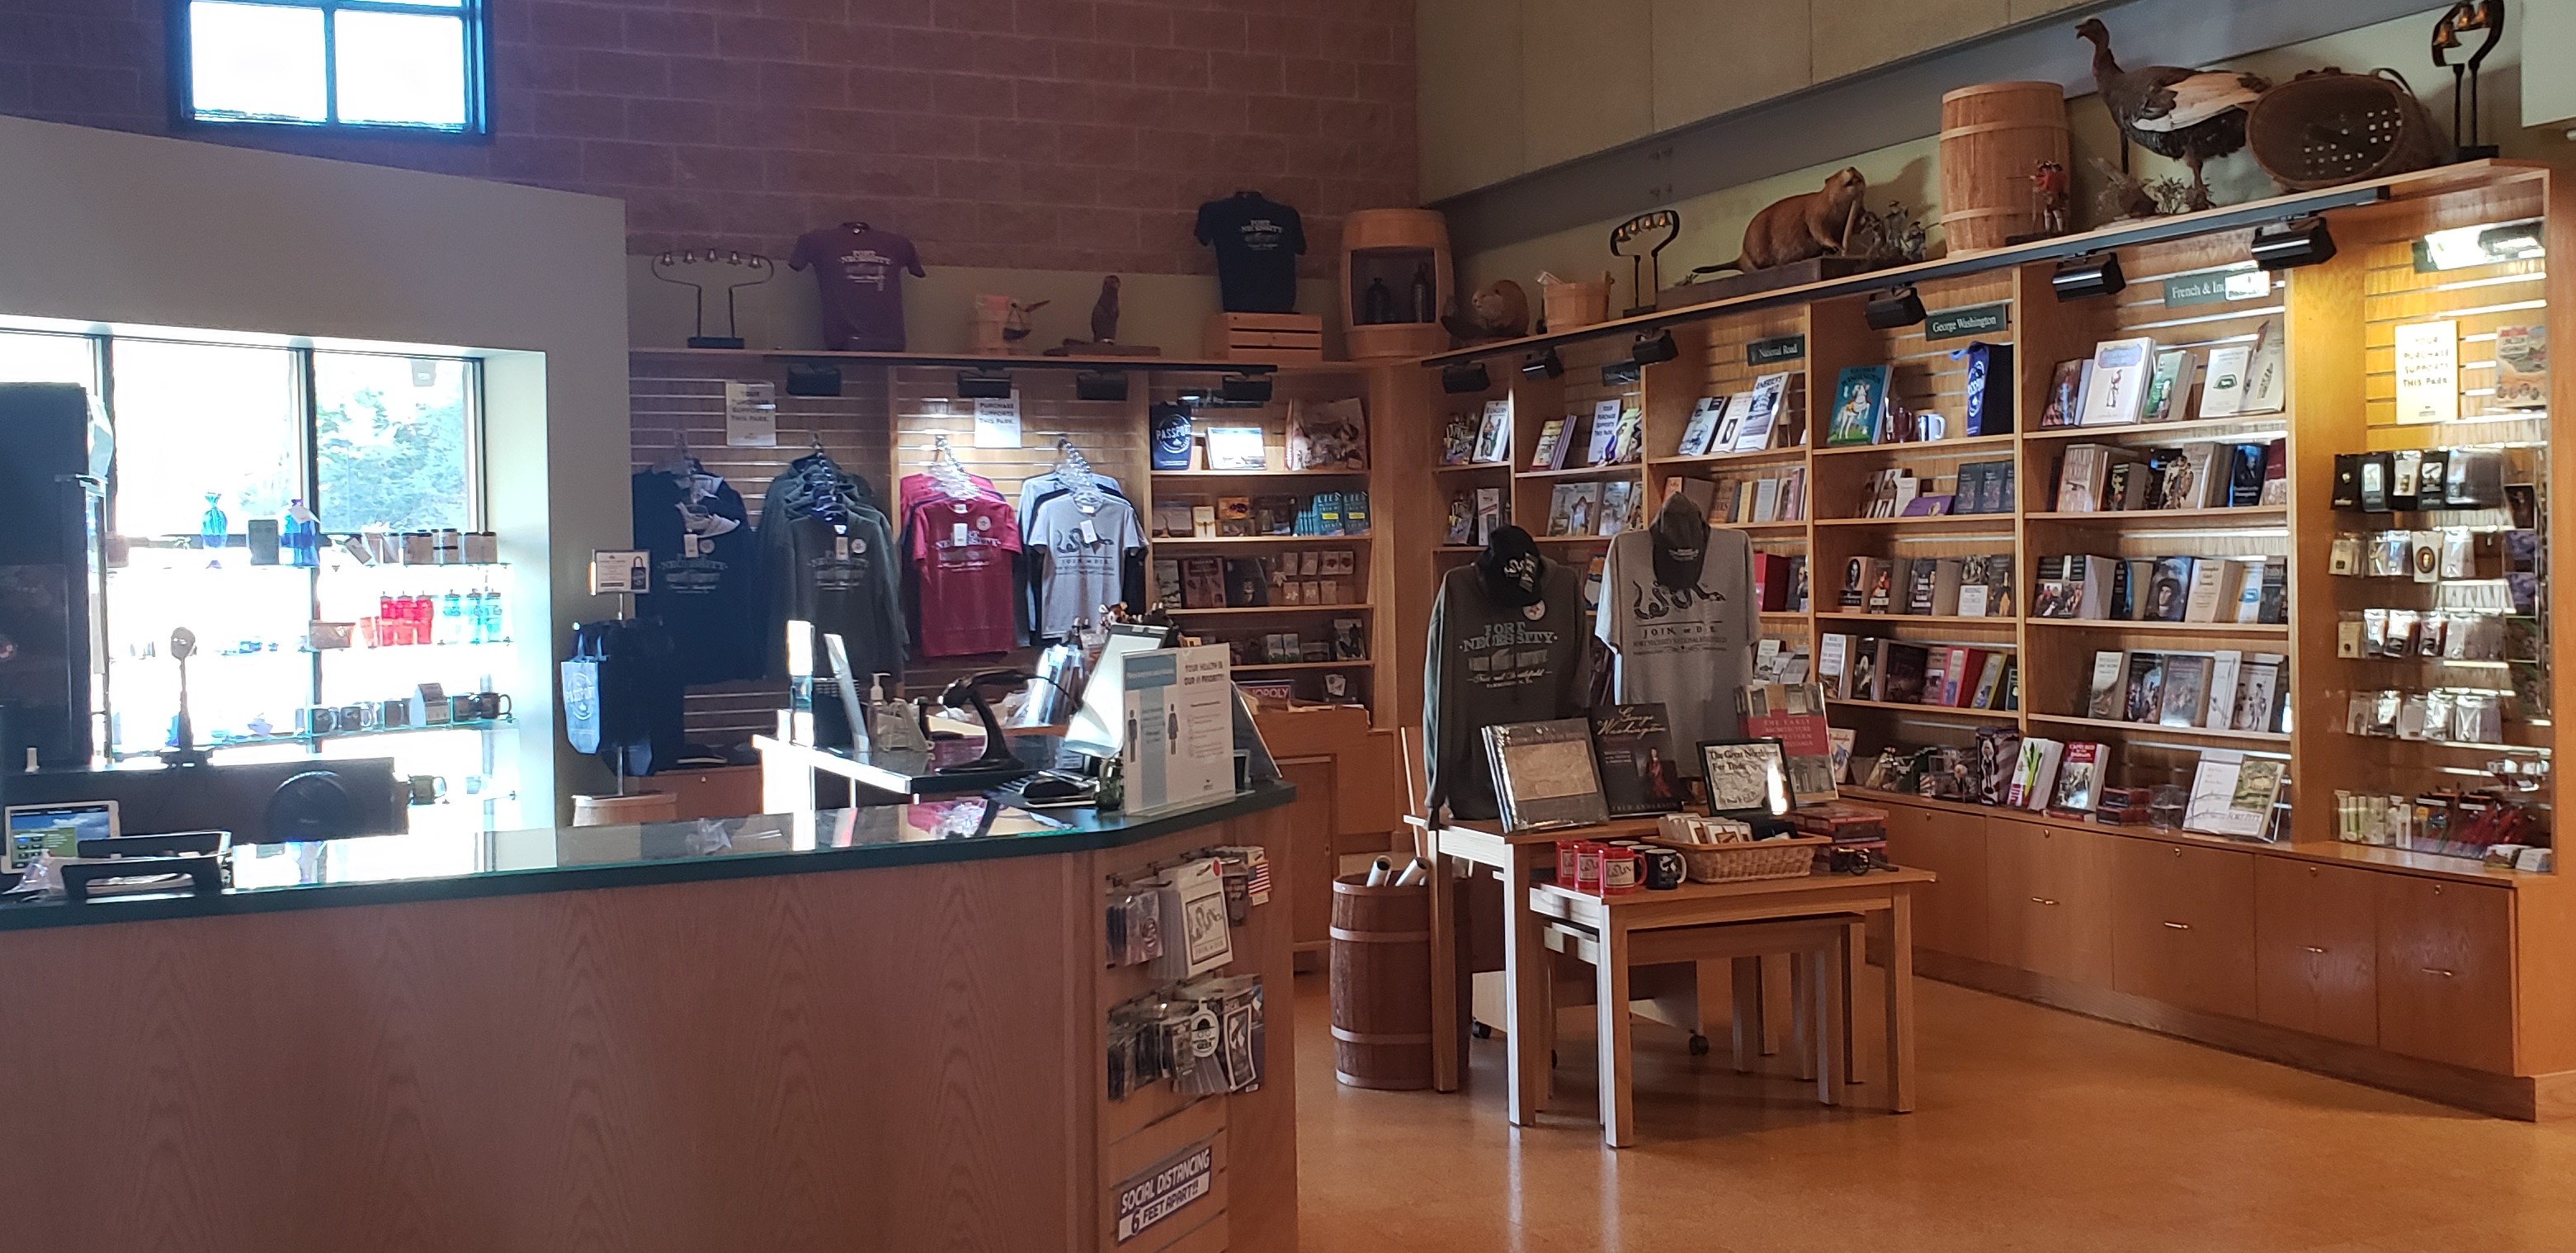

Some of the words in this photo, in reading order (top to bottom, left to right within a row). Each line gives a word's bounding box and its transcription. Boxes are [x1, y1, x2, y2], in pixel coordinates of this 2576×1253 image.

[2172, 285, 2201, 299] French
[2202, 281, 2210, 295] &
[1932, 322, 1956, 333] George
[1956, 316, 1997, 328] Washington
[1758, 346, 1782, 357] National
[1782, 343, 1798, 355] Road
[2403, 379, 2422, 387] THIS
[1317, 494, 1340, 503] LIES
[1343, 494, 1366, 503] LIES
[1484, 622, 1526, 636] FORT
[1463, 631, 1555, 652] NECESSITY
[1184, 677, 1195, 686] OUR
[1253, 688, 1289, 698] OPOLY
[1618, 706, 1654, 727] George
[1597, 717, 1667, 740] Washington
[1709, 750, 1724, 759] The
[1724, 749, 1743, 759] Great
[1712, 762, 1725, 772] Fur
[1121, 1180, 1155, 1214] SOCIAL
[1157, 1148, 1210, 1195] DISTANCING
[1130, 1208, 1141, 1236] 6
[1143, 1200, 1165, 1224] FEET
[1165, 1179, 1200, 1211] APART!!
